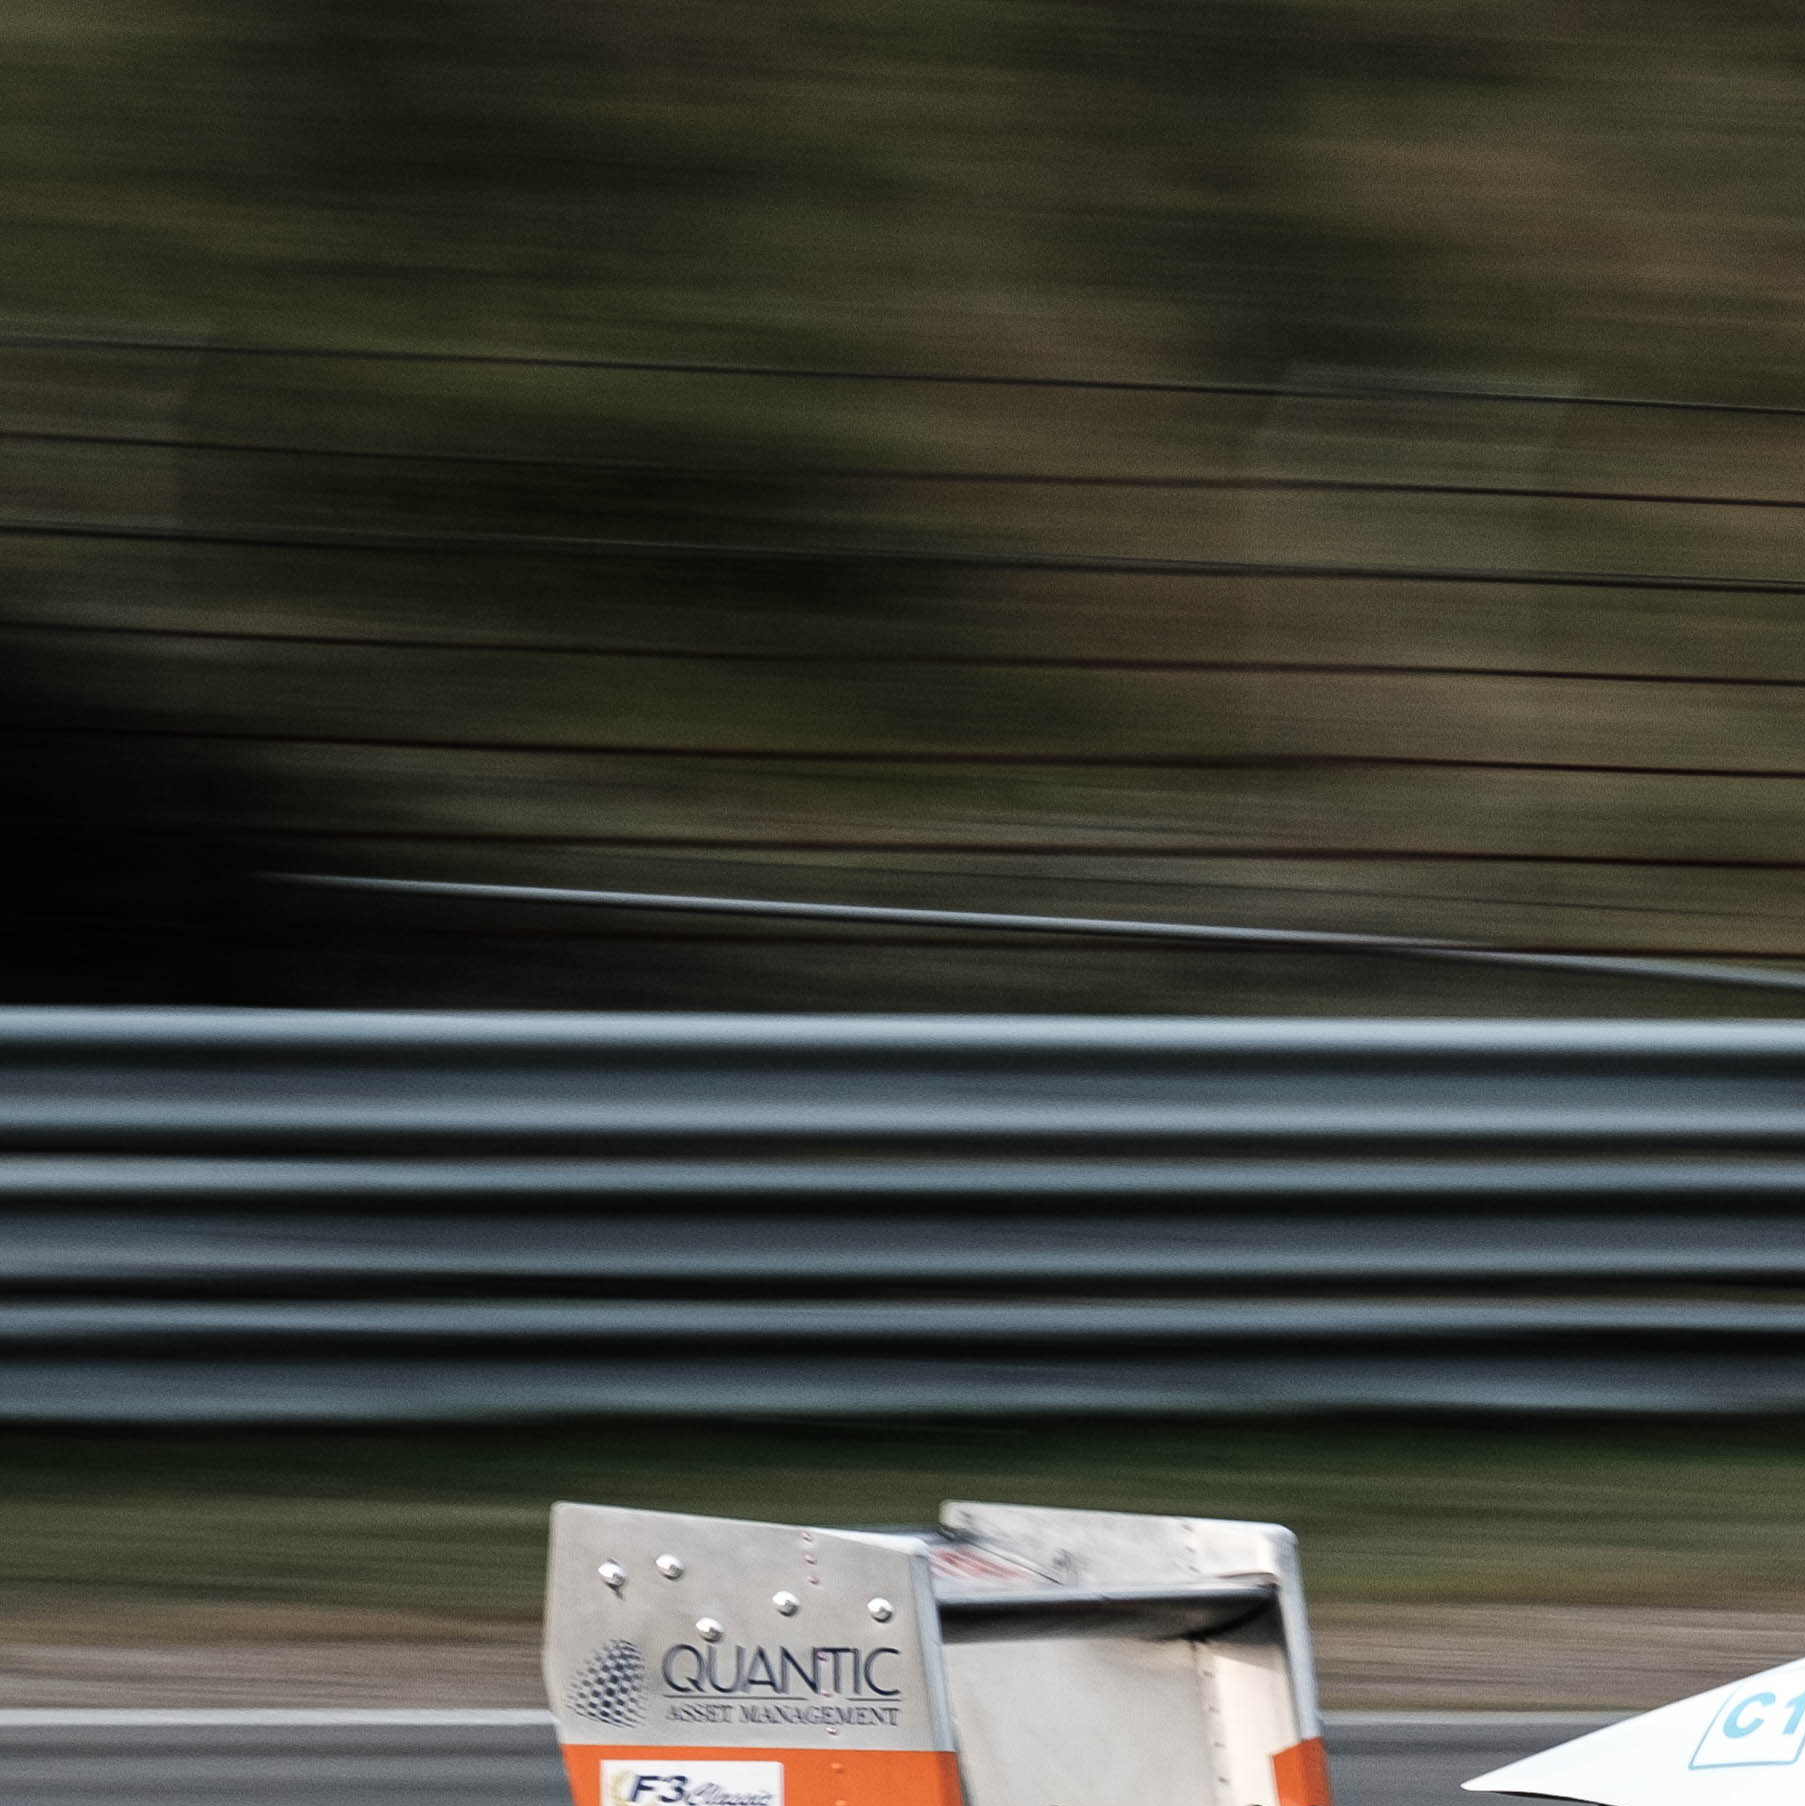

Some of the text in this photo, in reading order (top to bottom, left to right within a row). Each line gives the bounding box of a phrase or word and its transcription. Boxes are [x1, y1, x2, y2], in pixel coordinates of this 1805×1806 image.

[661, 1642, 901, 1697] QUANTIC
[665, 1703, 901, 1727] ASSET MANAGEMENT
[629, 1774, 690, 1804] F3
